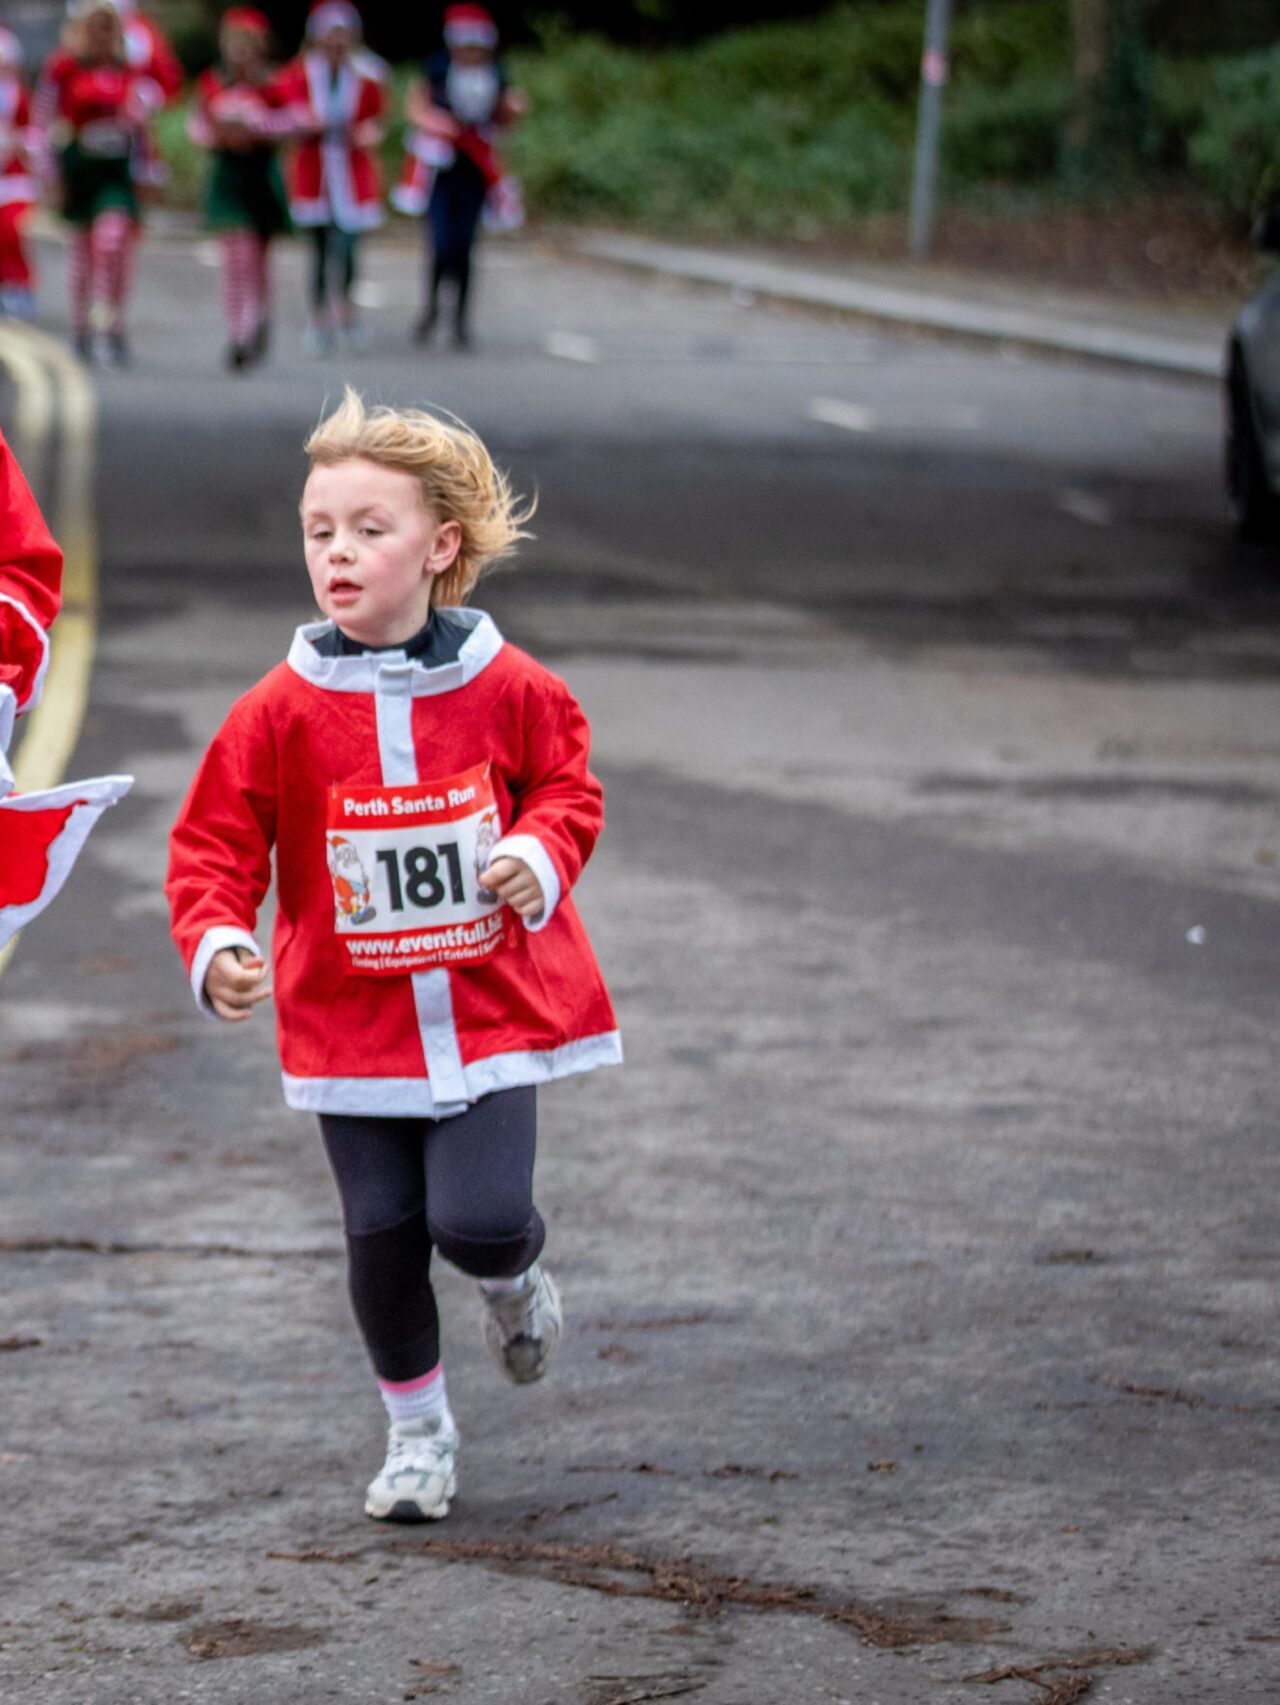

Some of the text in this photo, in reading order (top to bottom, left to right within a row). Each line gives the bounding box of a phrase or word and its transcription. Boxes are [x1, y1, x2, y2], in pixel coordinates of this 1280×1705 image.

[344, 786, 476, 816] Perth Santa Run
[376, 841, 465, 912] 181
